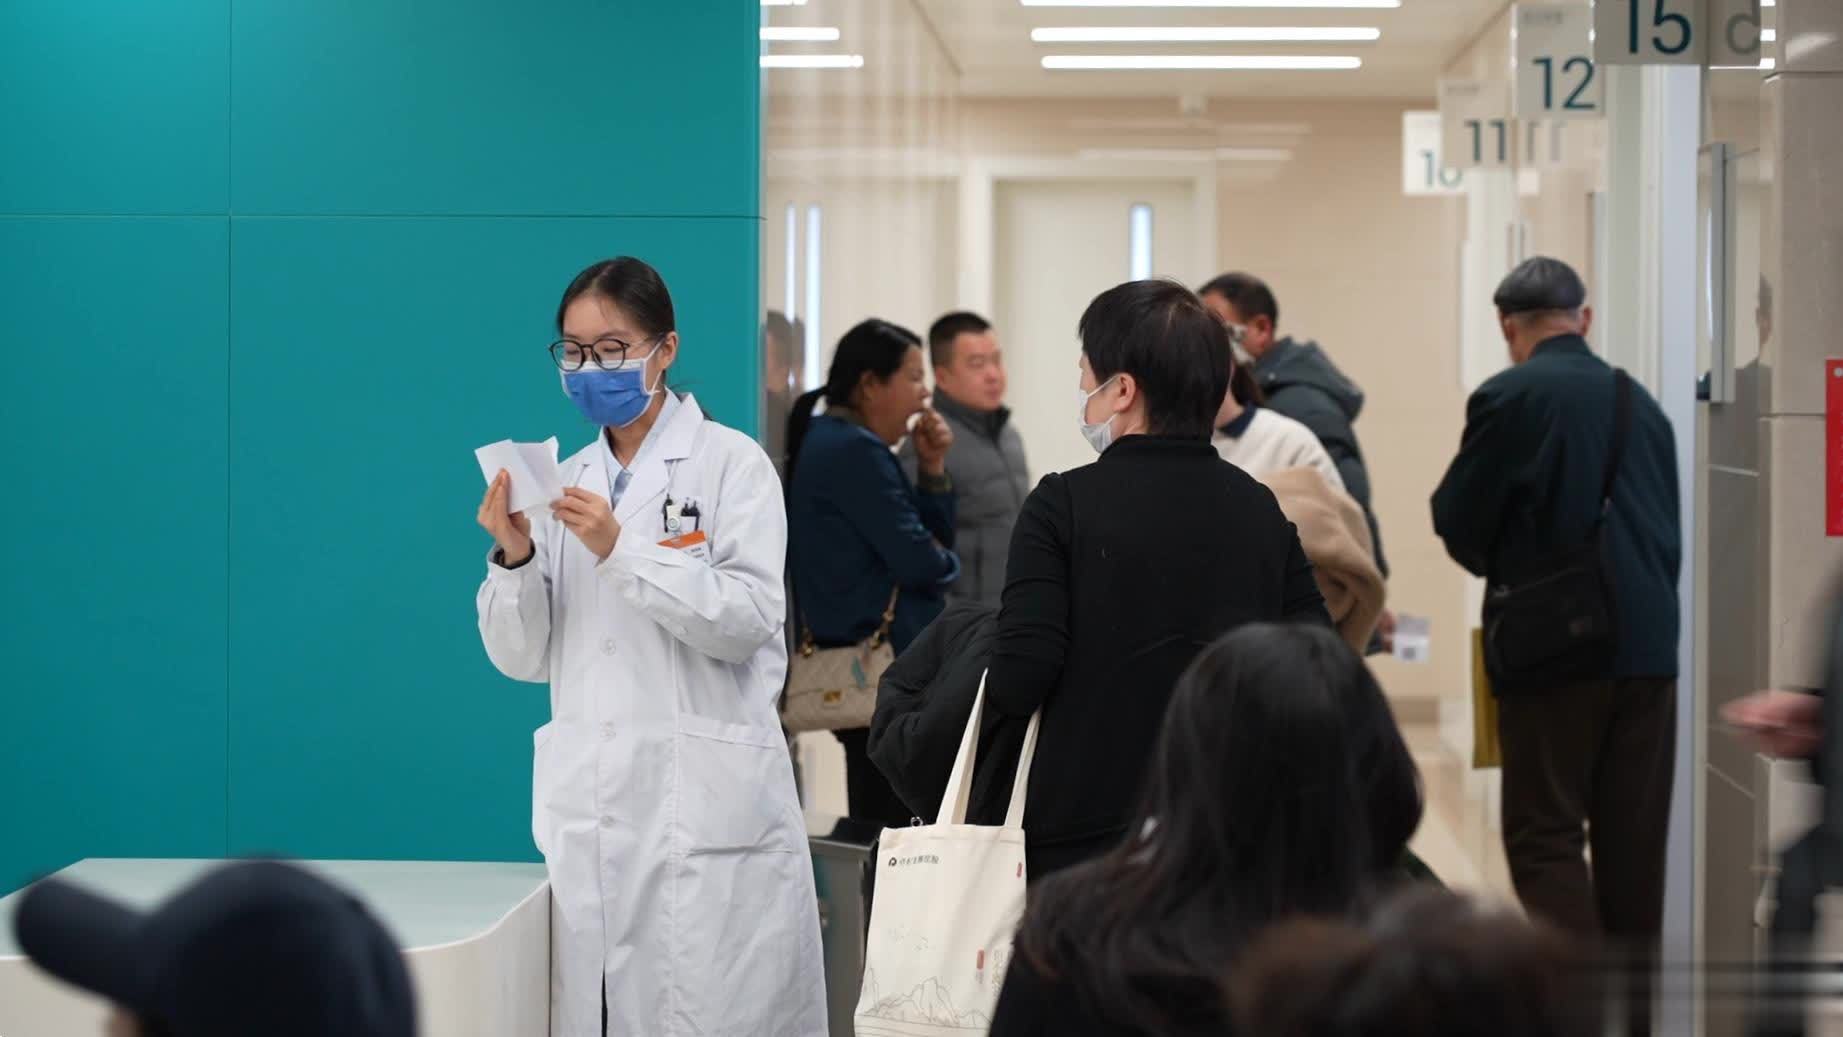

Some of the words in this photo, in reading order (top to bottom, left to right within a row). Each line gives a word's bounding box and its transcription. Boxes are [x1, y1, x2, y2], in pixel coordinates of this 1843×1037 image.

[1627, 0, 1692, 55] 15
[1532, 56, 1597, 110] 12
[1464, 119, 1507, 163] 11
